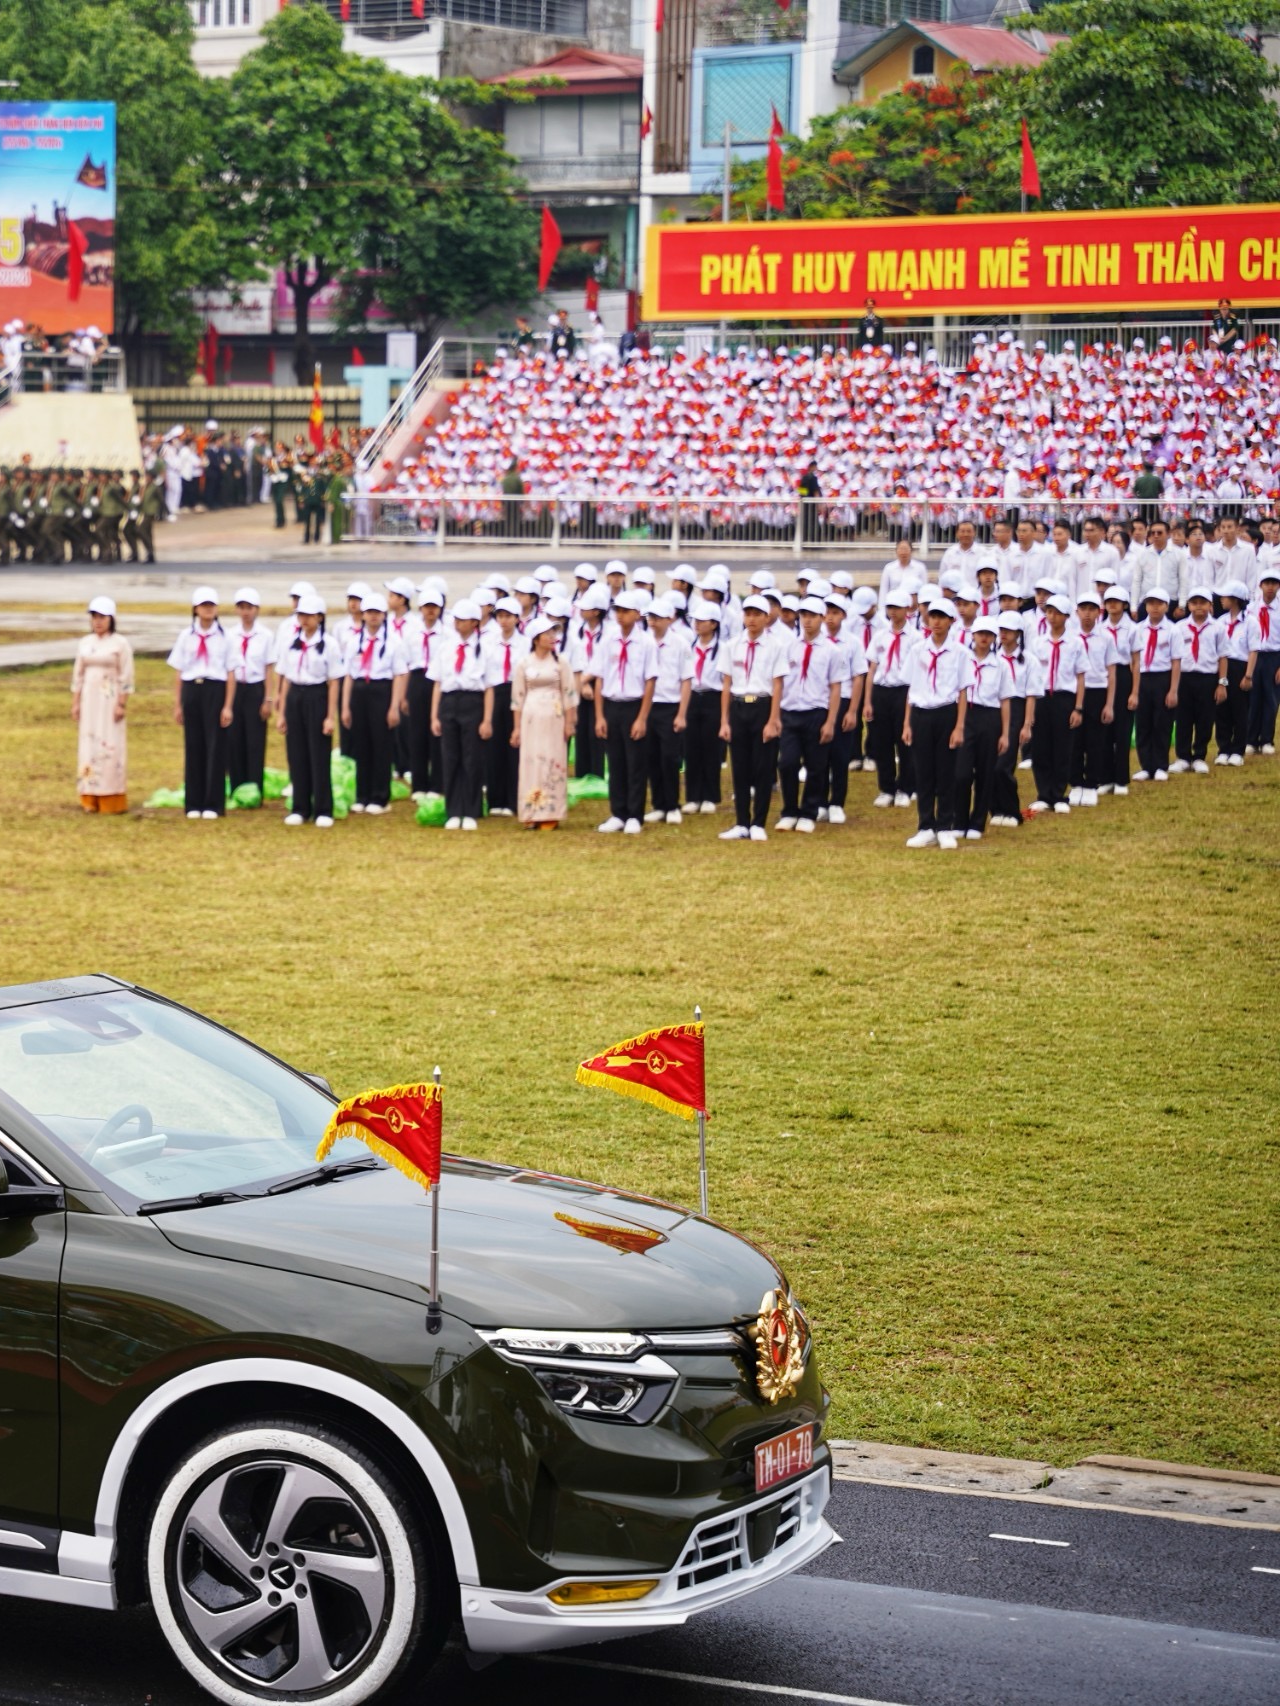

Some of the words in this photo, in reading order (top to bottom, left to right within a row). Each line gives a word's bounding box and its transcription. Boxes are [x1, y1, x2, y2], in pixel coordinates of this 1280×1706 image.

[700, 245, 782, 295] PHÁT
[791, 251, 856, 293] HUY
[867, 248, 966, 299] MẠNH
[978, 238, 1030, 288] MẼ
[1042, 243, 1121, 286] TINH
[1133, 226, 1225, 283] THẦN
[1239, 238, 1280, 281] CH
